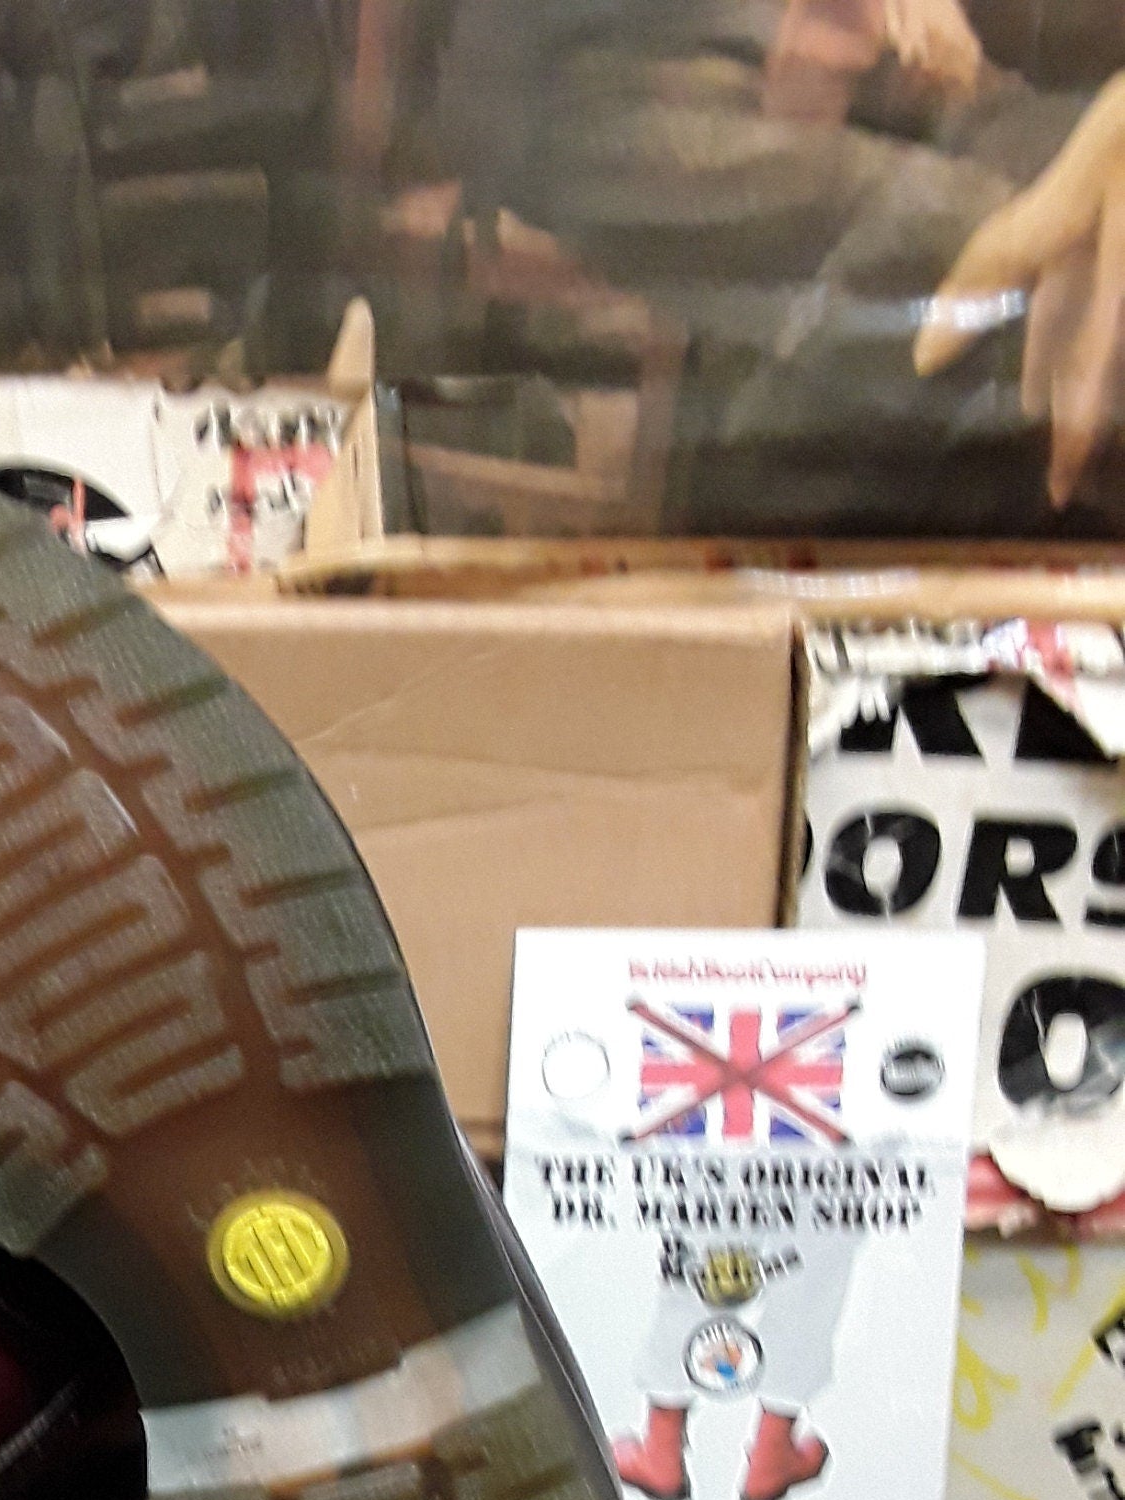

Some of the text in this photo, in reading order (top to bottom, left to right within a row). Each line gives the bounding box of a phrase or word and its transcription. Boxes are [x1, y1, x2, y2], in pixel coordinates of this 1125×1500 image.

[536, 1155, 616, 1188] THE
[741, 1157, 935, 1196] ORIGINAL
[638, 1197, 798, 1232] MARTEN
[813, 1199, 922, 1233] SHOP
